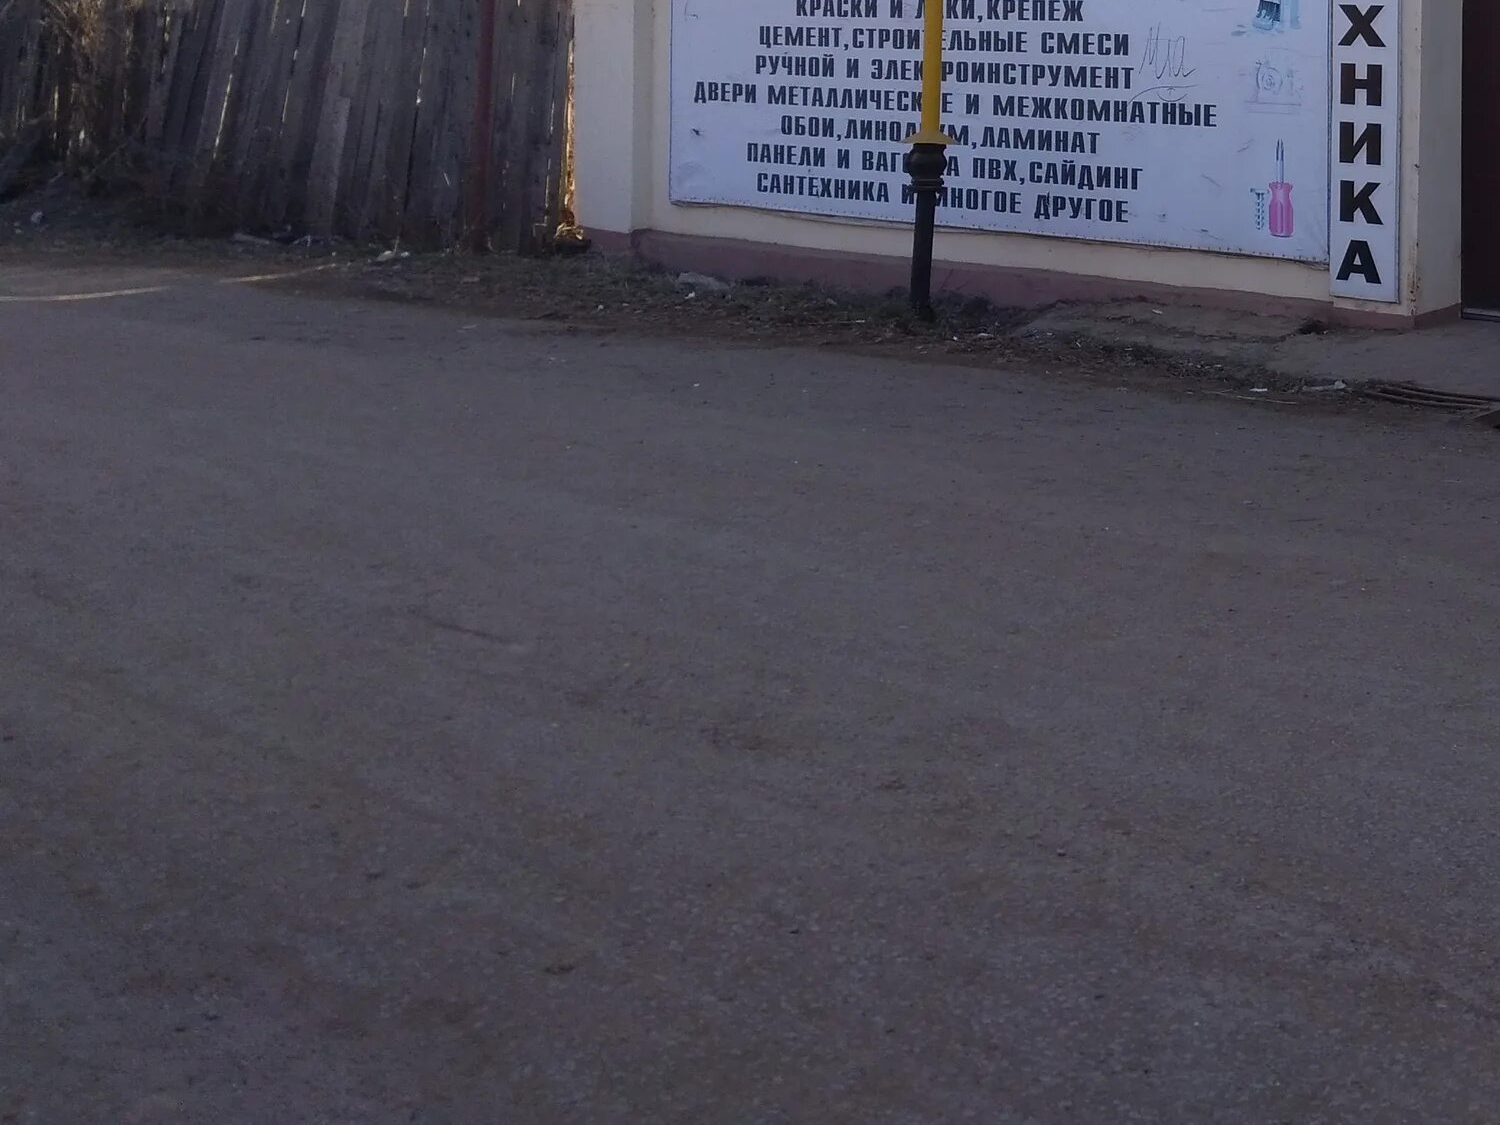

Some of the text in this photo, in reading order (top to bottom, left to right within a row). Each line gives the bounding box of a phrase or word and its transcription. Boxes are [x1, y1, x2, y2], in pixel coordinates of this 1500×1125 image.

[758, 26, 1028, 53] ЦЕМЕНТ,СТРОИЛЬНЫЕ
[1041, 31, 1130, 57] СМЕСИ
[755, 54, 1134, 90] РУЧНОЙ И ЭЛЕКРОИНСТРУМЕНТ
[694, 81, 1217, 128] ДВЕРИ МЕТАЛЛИЧЕСКЕ И МЕЖКОМНАТНЫЕ
[780, 115, 1101, 154] ОБОИ,ЛИНОЛМ,ЛАМИНАТ
[747, 142, 826, 168] ПАНЕЛИ
[837, 148, 850, 170] И
[862, 150, 960, 177] ВАГА
[757, 172, 890, 203] САНТЕХНИКА
[1034, 191, 1129, 223] ДРУГОЕ
